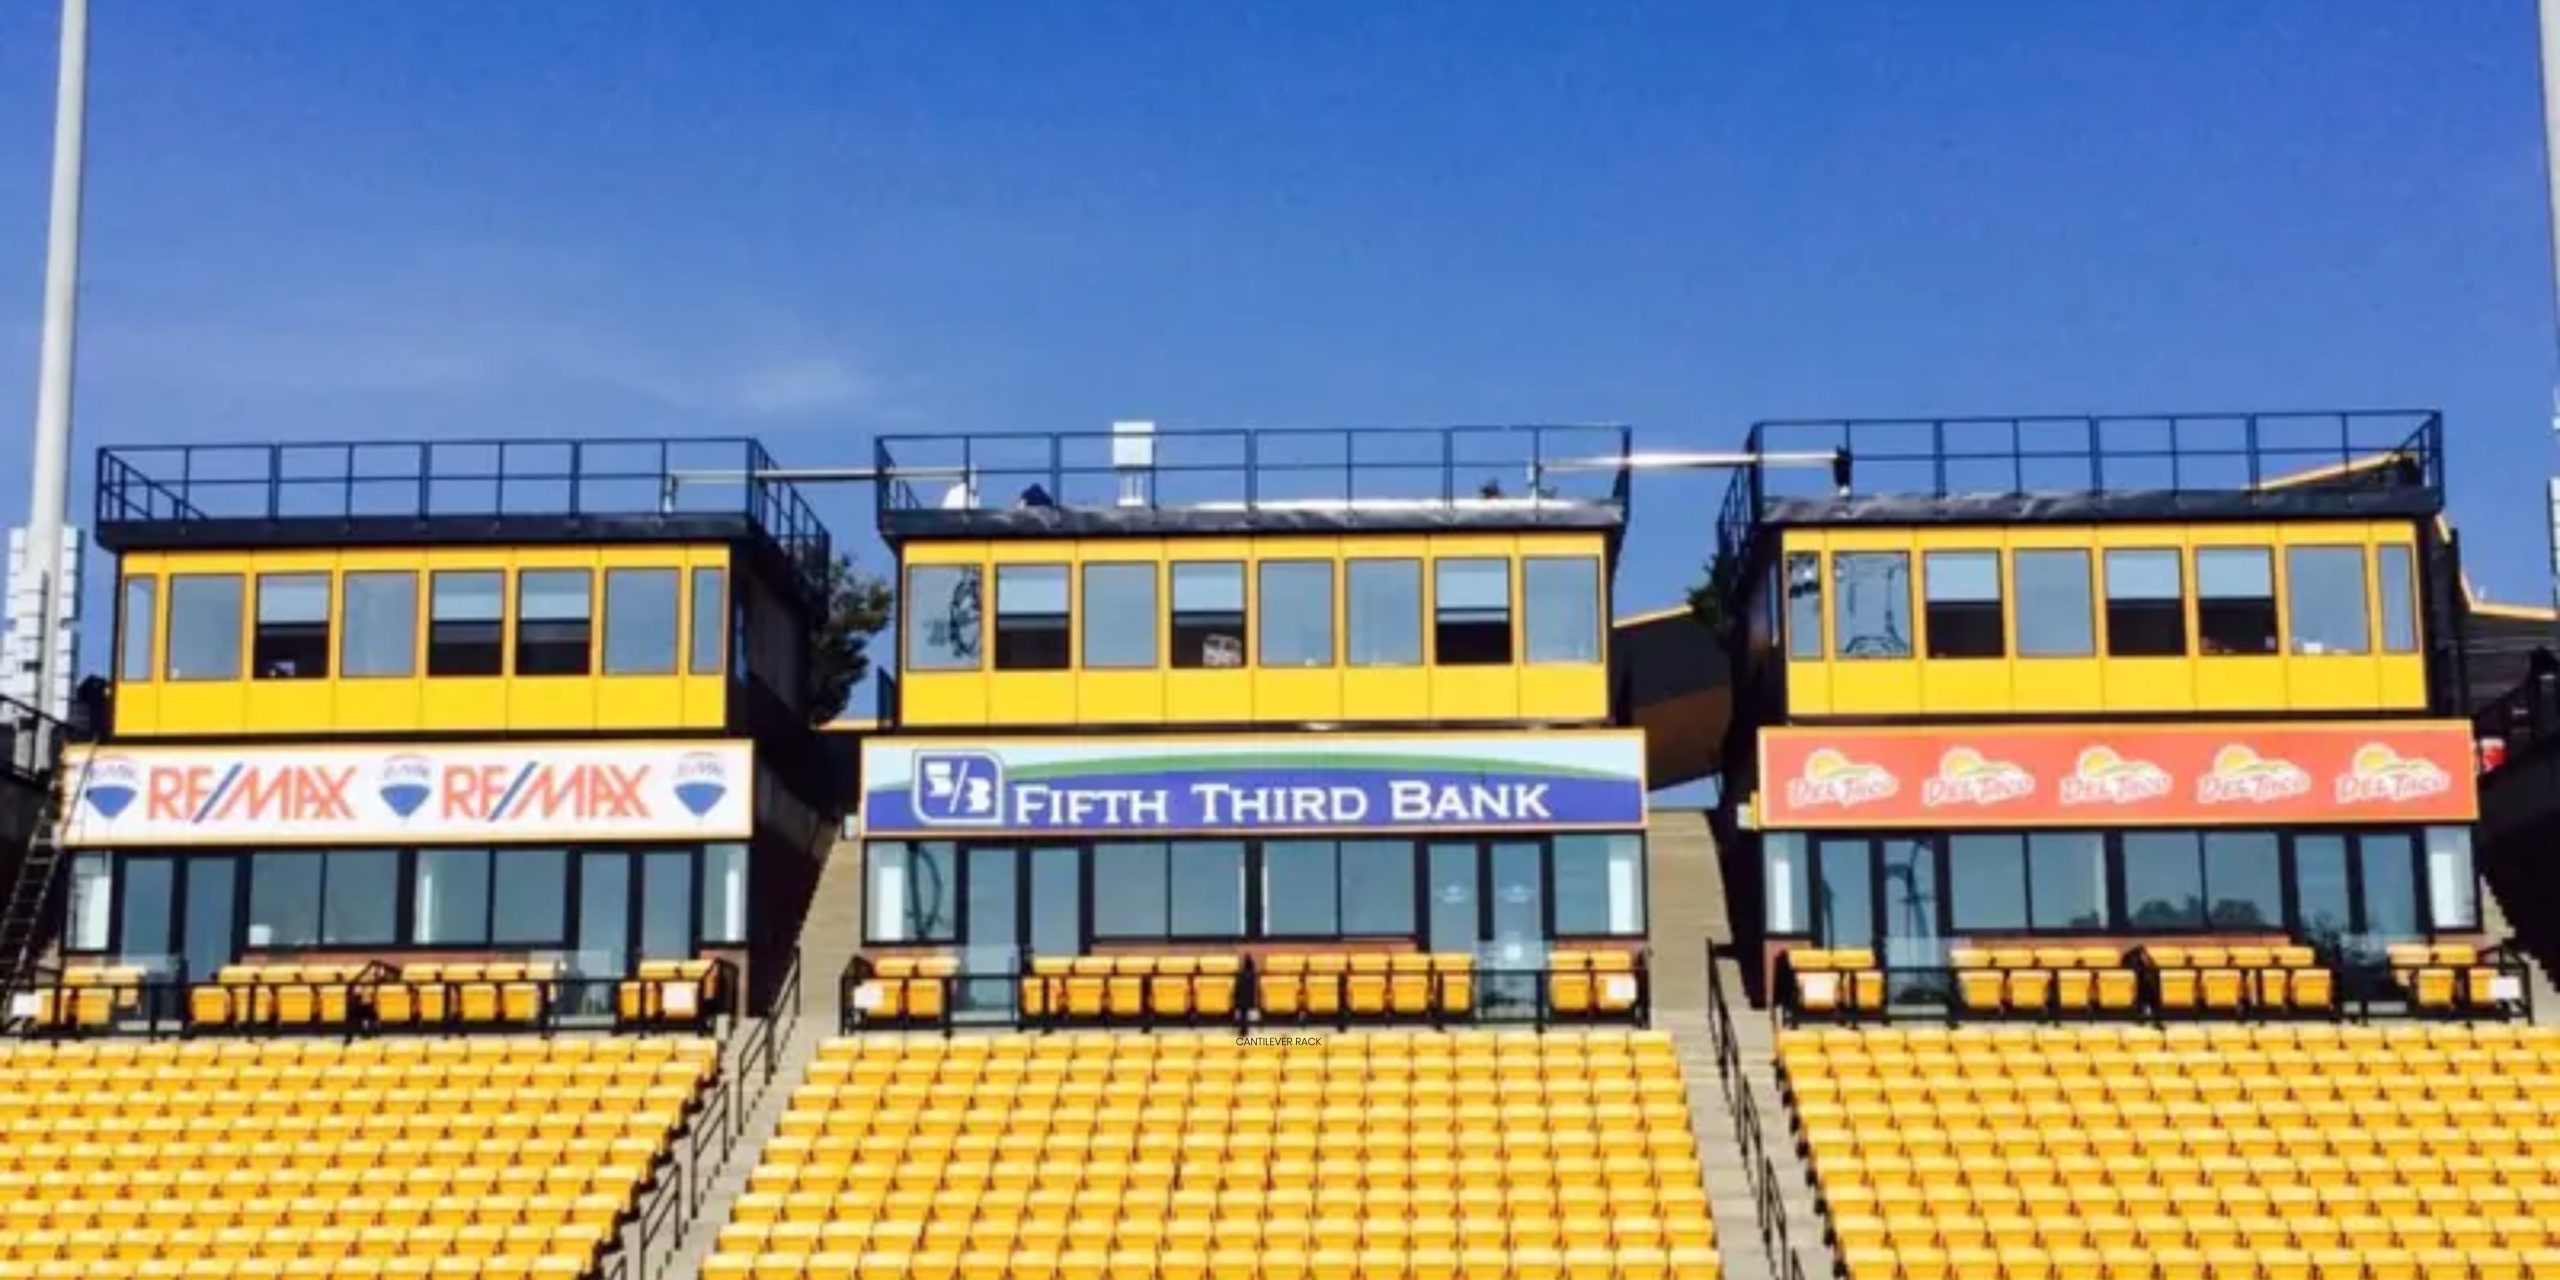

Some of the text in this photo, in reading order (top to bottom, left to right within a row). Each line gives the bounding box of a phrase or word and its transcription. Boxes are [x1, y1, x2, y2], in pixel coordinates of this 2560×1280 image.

[147, 762, 357, 823] RE/MAX
[442, 761, 651, 822] RE/MAX
[1014, 780, 1551, 824] FIFTH THIRD BANK
